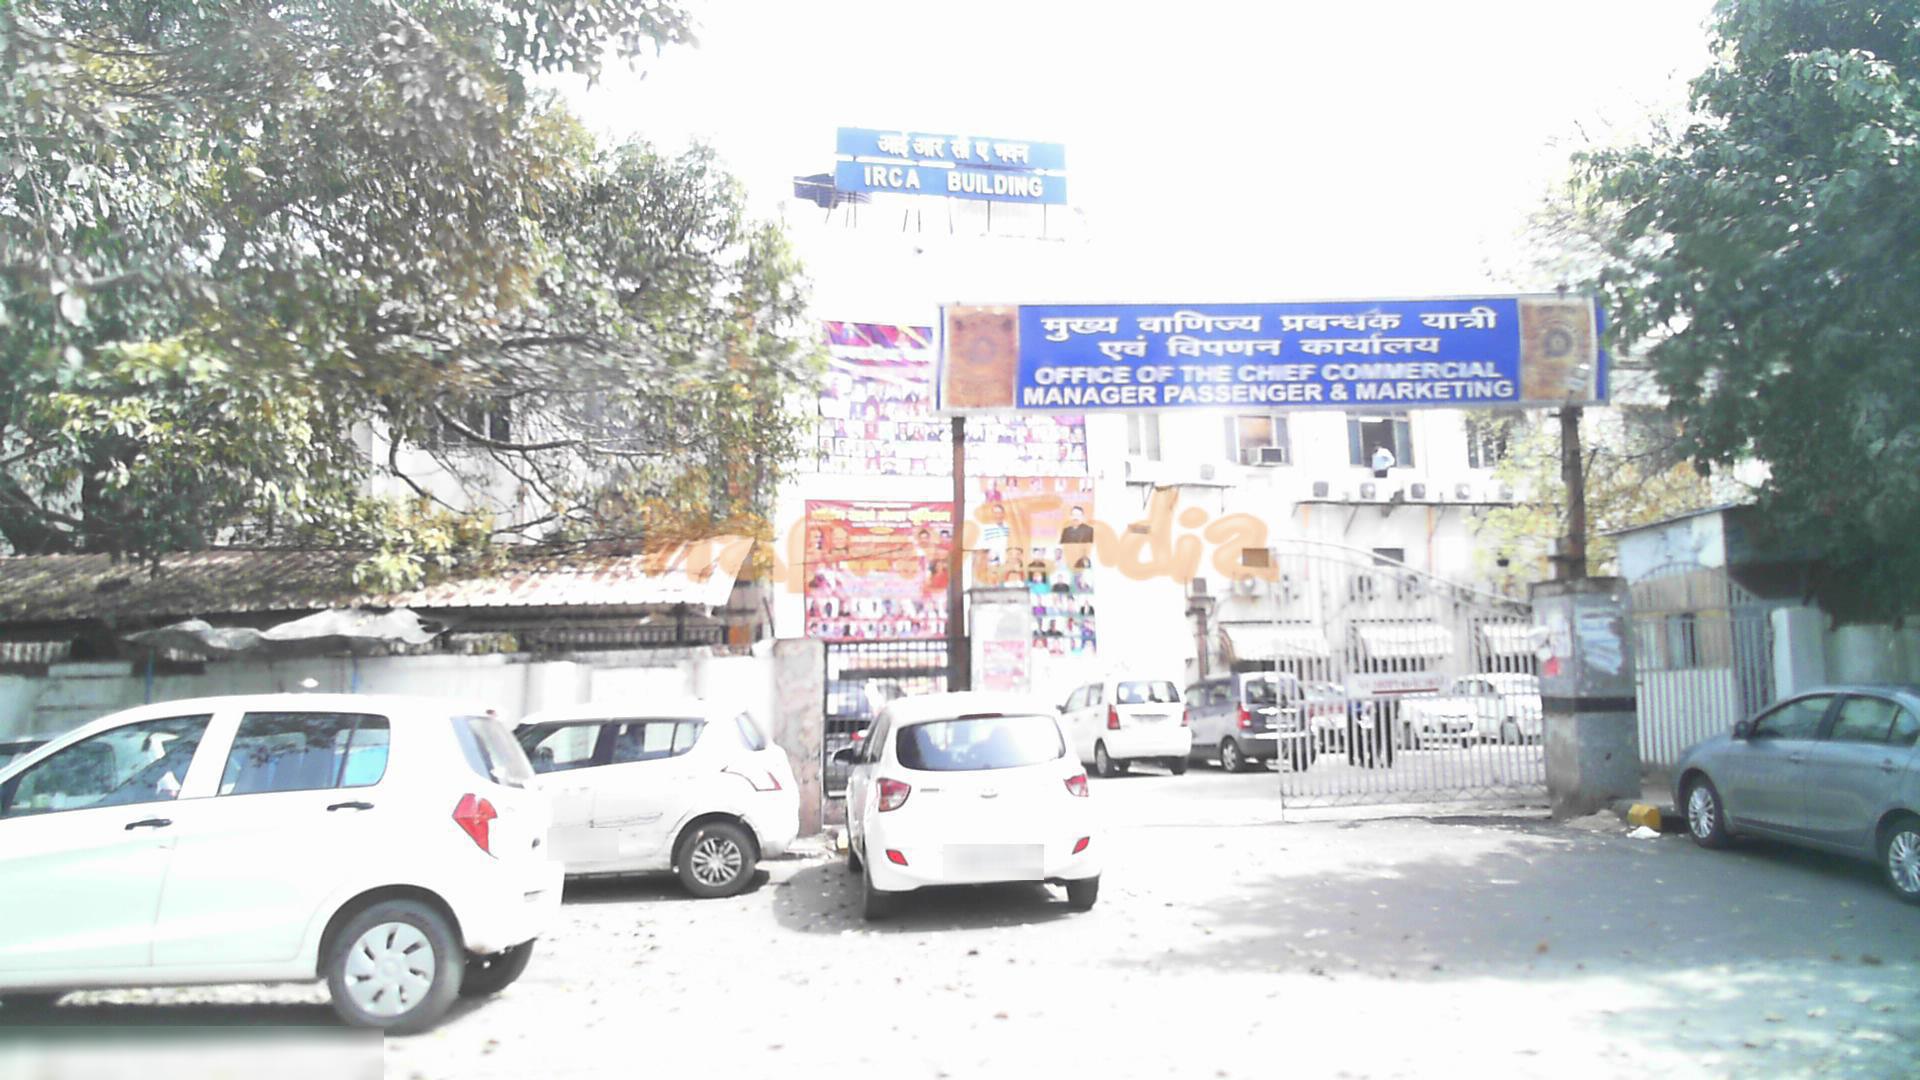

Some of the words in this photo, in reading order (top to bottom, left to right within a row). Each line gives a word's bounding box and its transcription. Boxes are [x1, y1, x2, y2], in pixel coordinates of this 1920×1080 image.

[863, 166, 920, 189] IRCA
[947, 171, 1043, 197] BUILDING
[1041, 315, 1120, 342] मुख्य
[1137, 310, 1262, 334] वाणिज्य
[1419, 306, 1497, 329] यात्री
[1098, 334, 1148, 361] एवं
[1166, 335, 1282, 357] विपणन
[1299, 332, 1441, 355] कार्यालय
[1034, 365, 1132, 385] OFFICE
[1136, 365, 1175, 384] OF
[1180, 363, 1233, 383] THE
[1237, 363, 1317, 382] CHIEF
[1321, 361, 1503, 380] COMMERCIAL
[1023, 385, 1157, 406] MANAGER
[1163, 382, 1323, 404] PASSENGER
[1329, 383, 1348, 402] &
[1355, 380, 1514, 401] MARKETING
